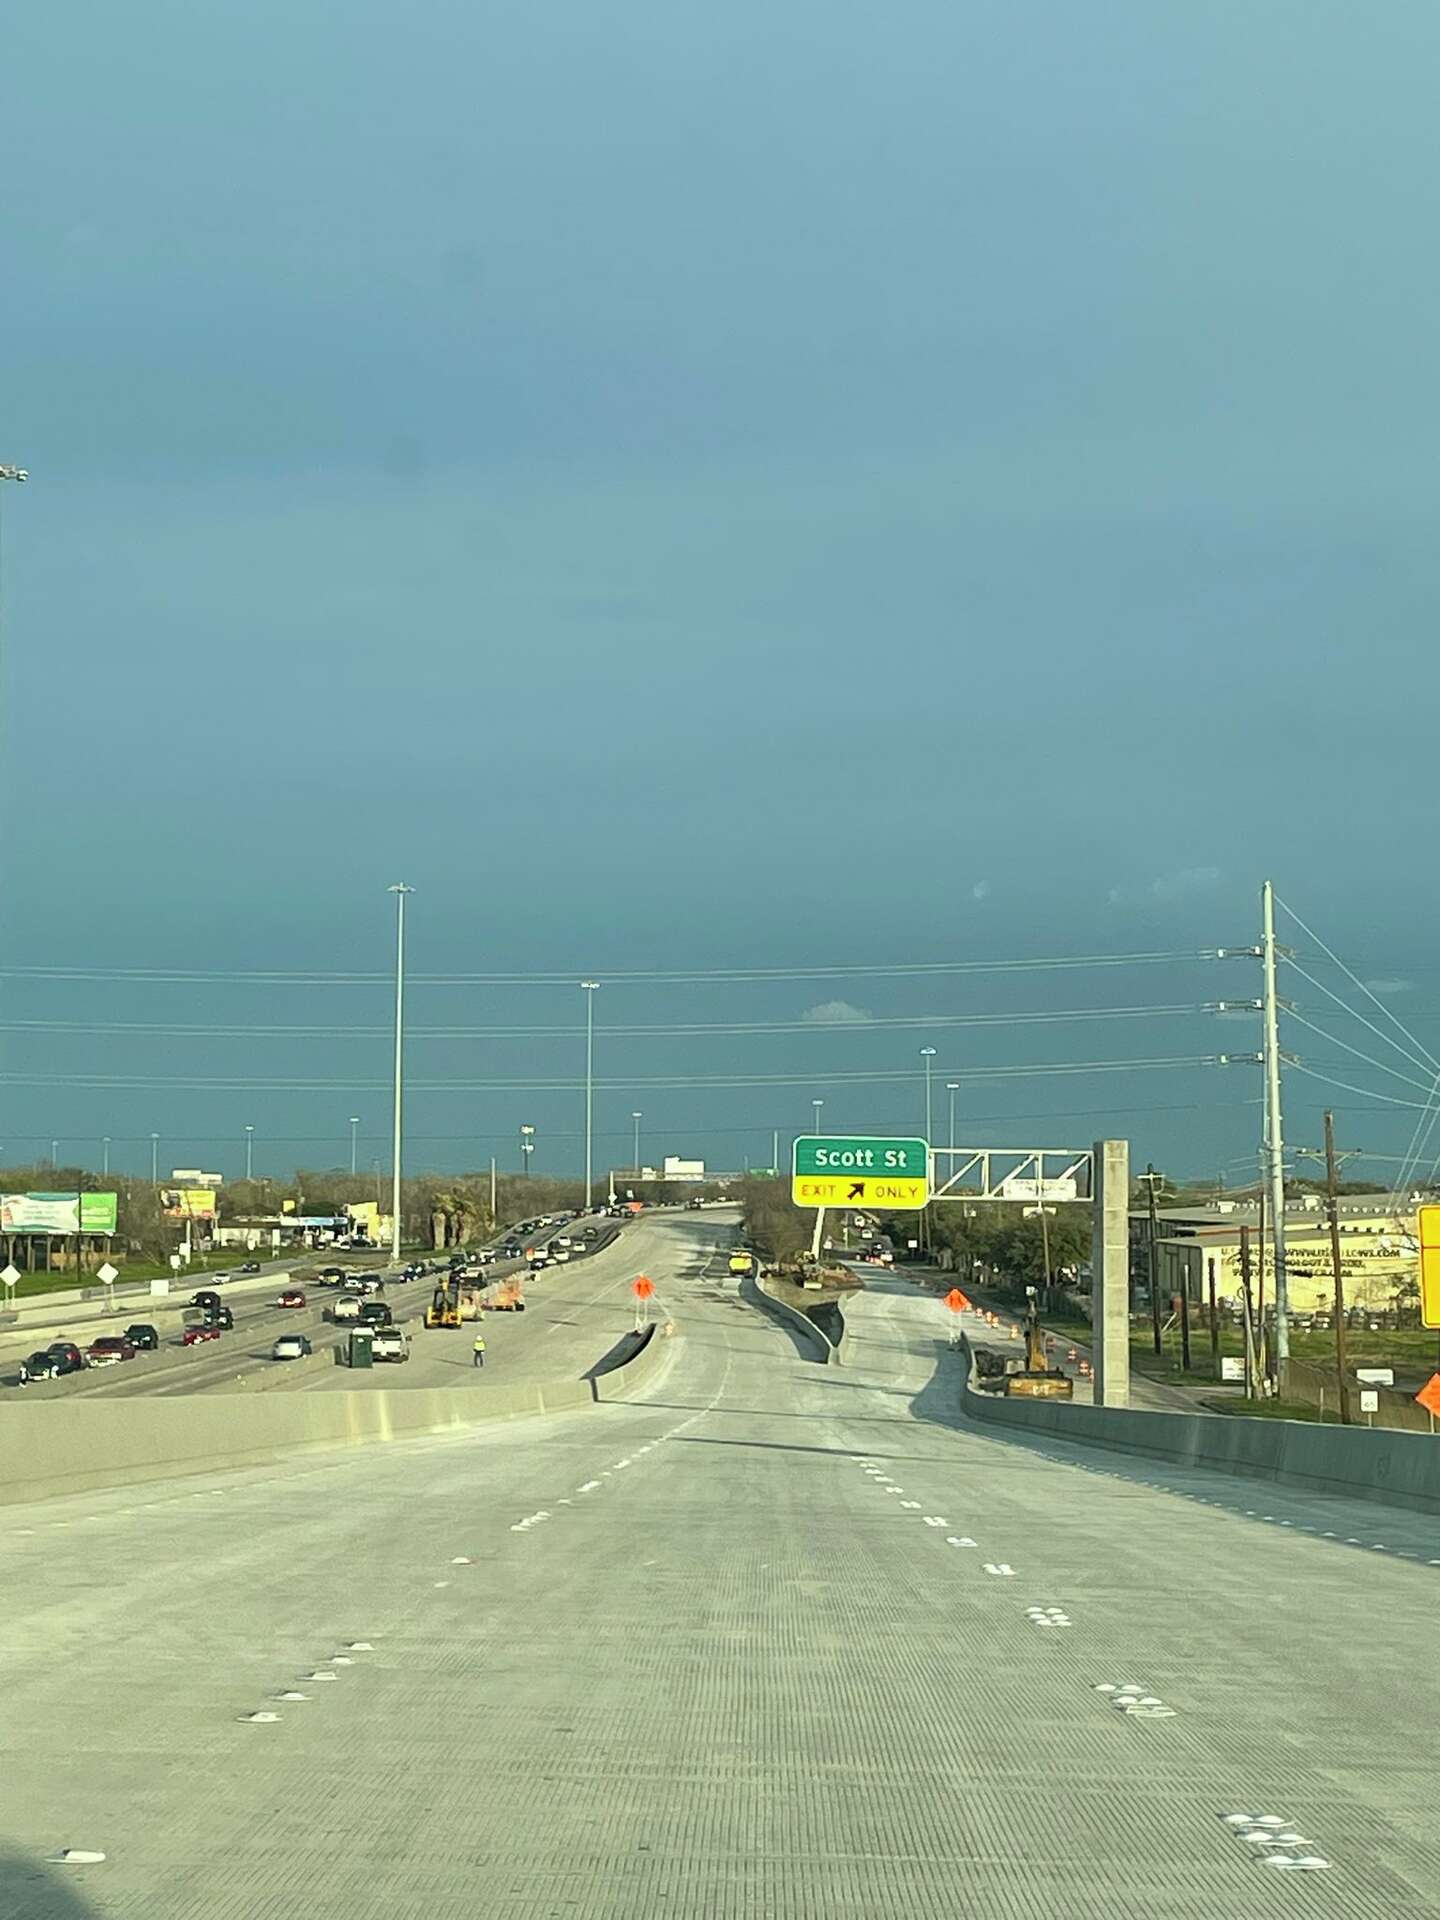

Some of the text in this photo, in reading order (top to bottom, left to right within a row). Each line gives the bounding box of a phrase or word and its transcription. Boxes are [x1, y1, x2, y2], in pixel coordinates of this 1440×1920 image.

[815, 1149, 907, 1168] Scott St
[801, 1184, 919, 1198] EXIT ONLY
